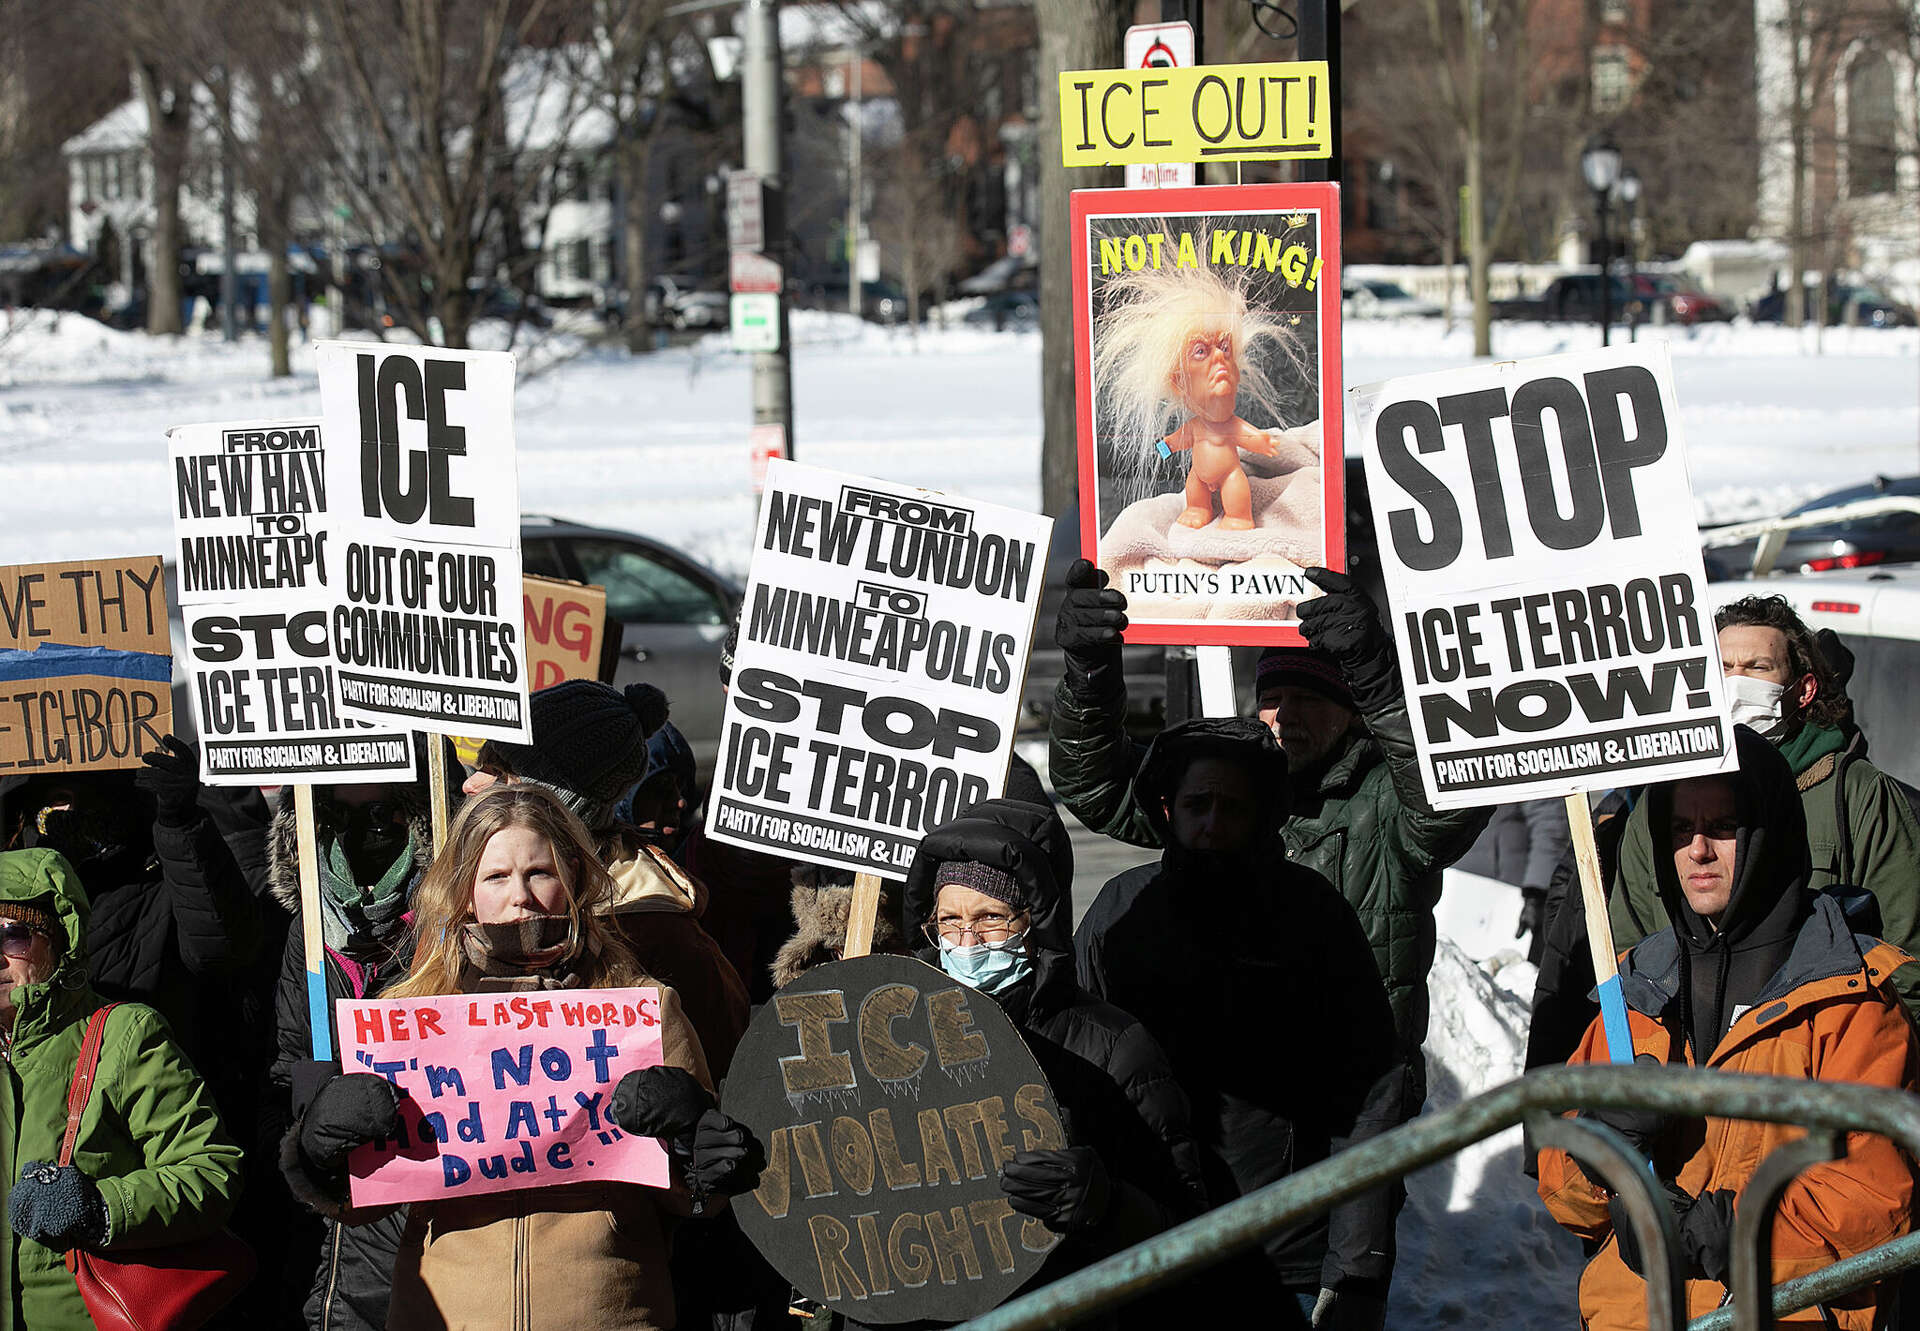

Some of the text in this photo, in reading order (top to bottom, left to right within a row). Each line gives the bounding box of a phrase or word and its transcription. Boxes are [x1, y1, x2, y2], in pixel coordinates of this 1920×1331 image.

[1074, 74, 1316, 150] ICE OUT!
[1099, 230, 1324, 292] NOT A KING!
[228, 430, 316, 452] FROM
[356, 353, 475, 528] ICE
[1376, 365, 1668, 571] STOP
[175, 454, 252, 519] NEW
[845, 490, 967, 533] FROM
[256, 515, 301, 535] TO
[764, 490, 862, 567] NEW
[60, 565, 160, 635] THY
[347, 543, 497, 616] OUT OF OUR
[862, 585, 920, 614] TO
[1130, 573, 1305, 595] PUTIN'S PAWN
[334, 604, 518, 683] COMMUNITIES
[748, 583, 1015, 694] MINNEAPOLIS
[1405, 573, 1703, 685] ICE TERROR
[197, 669, 255, 735] ICE
[341, 678, 519, 722] PARTY FOR SOCIALISM & LIBERATION
[733, 667, 1000, 759] STOP
[1419, 656, 1712, 744] NOW!
[208, 741, 406, 769] PARTY FOR SOCIALISM & LIBERATION
[723, 722, 799, 804] ICE
[1436, 725, 1719, 785] PARTY FOR SOCIALISM & LIBERATION
[718, 804, 762, 835] PARTY
[760, 814, 791, 843] FOR
[790, 821, 870, 859] SOCIALISM
[870, 840, 891, 864] &
[353, 1007, 447, 1044] HER
[468, 997, 553, 1030] LAST
[775, 982, 991, 1096] ICE
